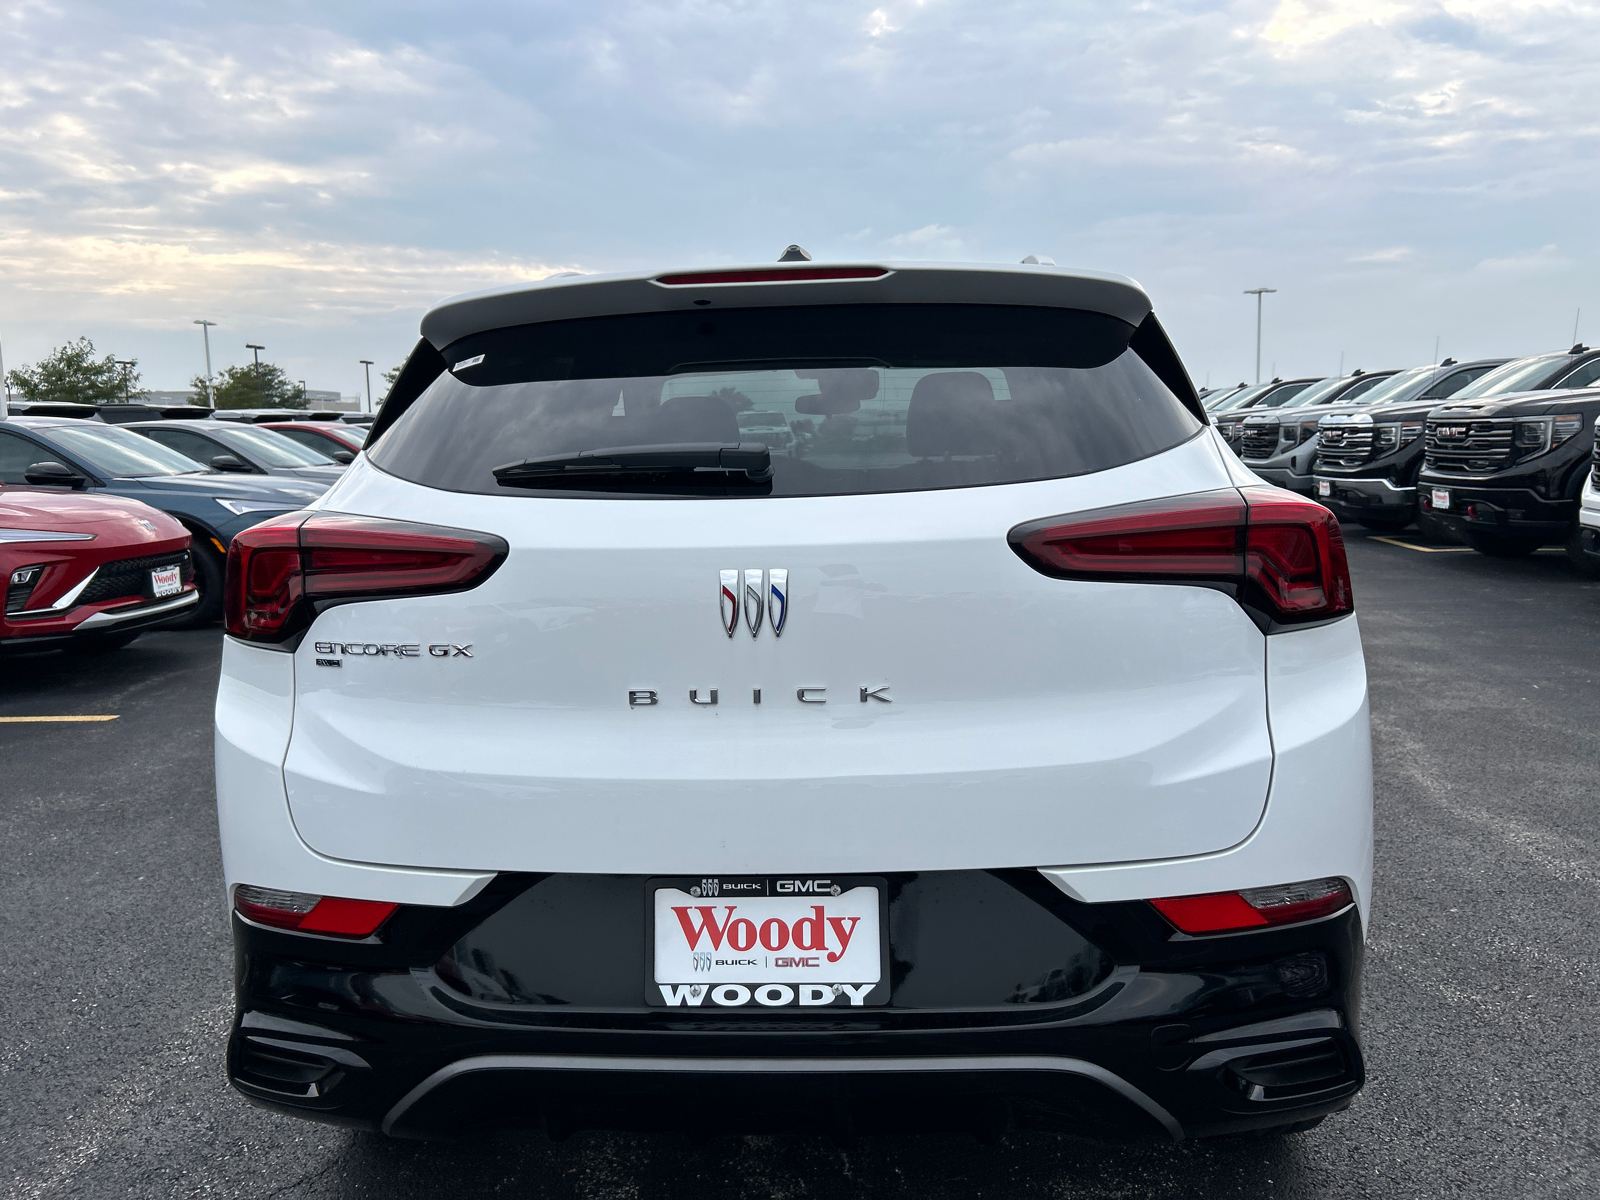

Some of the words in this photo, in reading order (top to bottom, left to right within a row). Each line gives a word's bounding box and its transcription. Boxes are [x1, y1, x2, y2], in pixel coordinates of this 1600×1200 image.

[153, 572, 177, 584] Woody
[314, 641, 421, 657] ENCORE
[428, 643, 474, 658] GX
[628, 686, 893, 706] BUICK
[776, 879, 832, 893] GMC
[670, 905, 861, 963] Woody
[715, 958, 758, 966] BUICK
[774, 956, 820, 968] GMC
[658, 984, 877, 1006] WOODY
